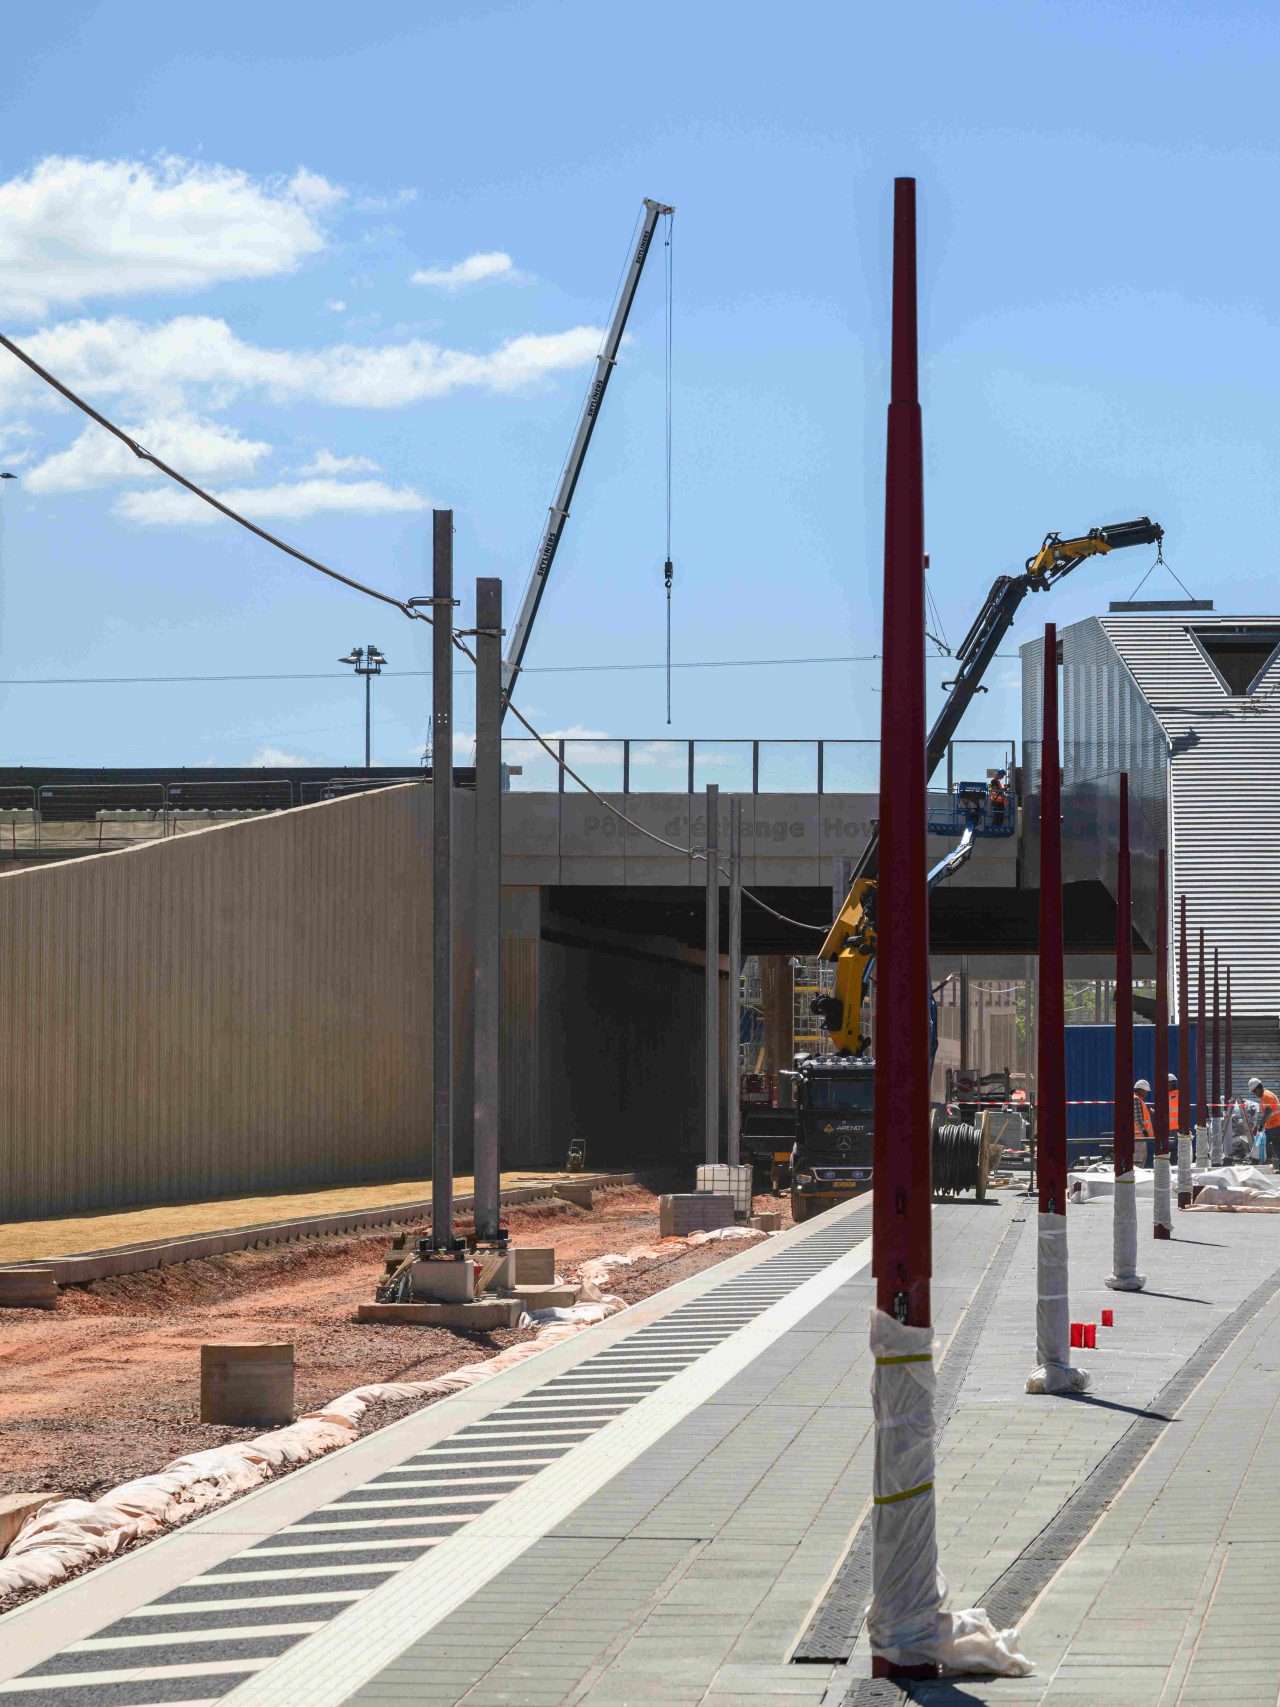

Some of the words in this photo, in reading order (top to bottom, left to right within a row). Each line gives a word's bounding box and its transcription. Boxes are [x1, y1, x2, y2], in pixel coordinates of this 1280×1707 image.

[587, 379, 604, 417] SKYLINERS
[537, 532, 556, 577] SKYLINERS
[665, 816, 805, 842] d'éhange
